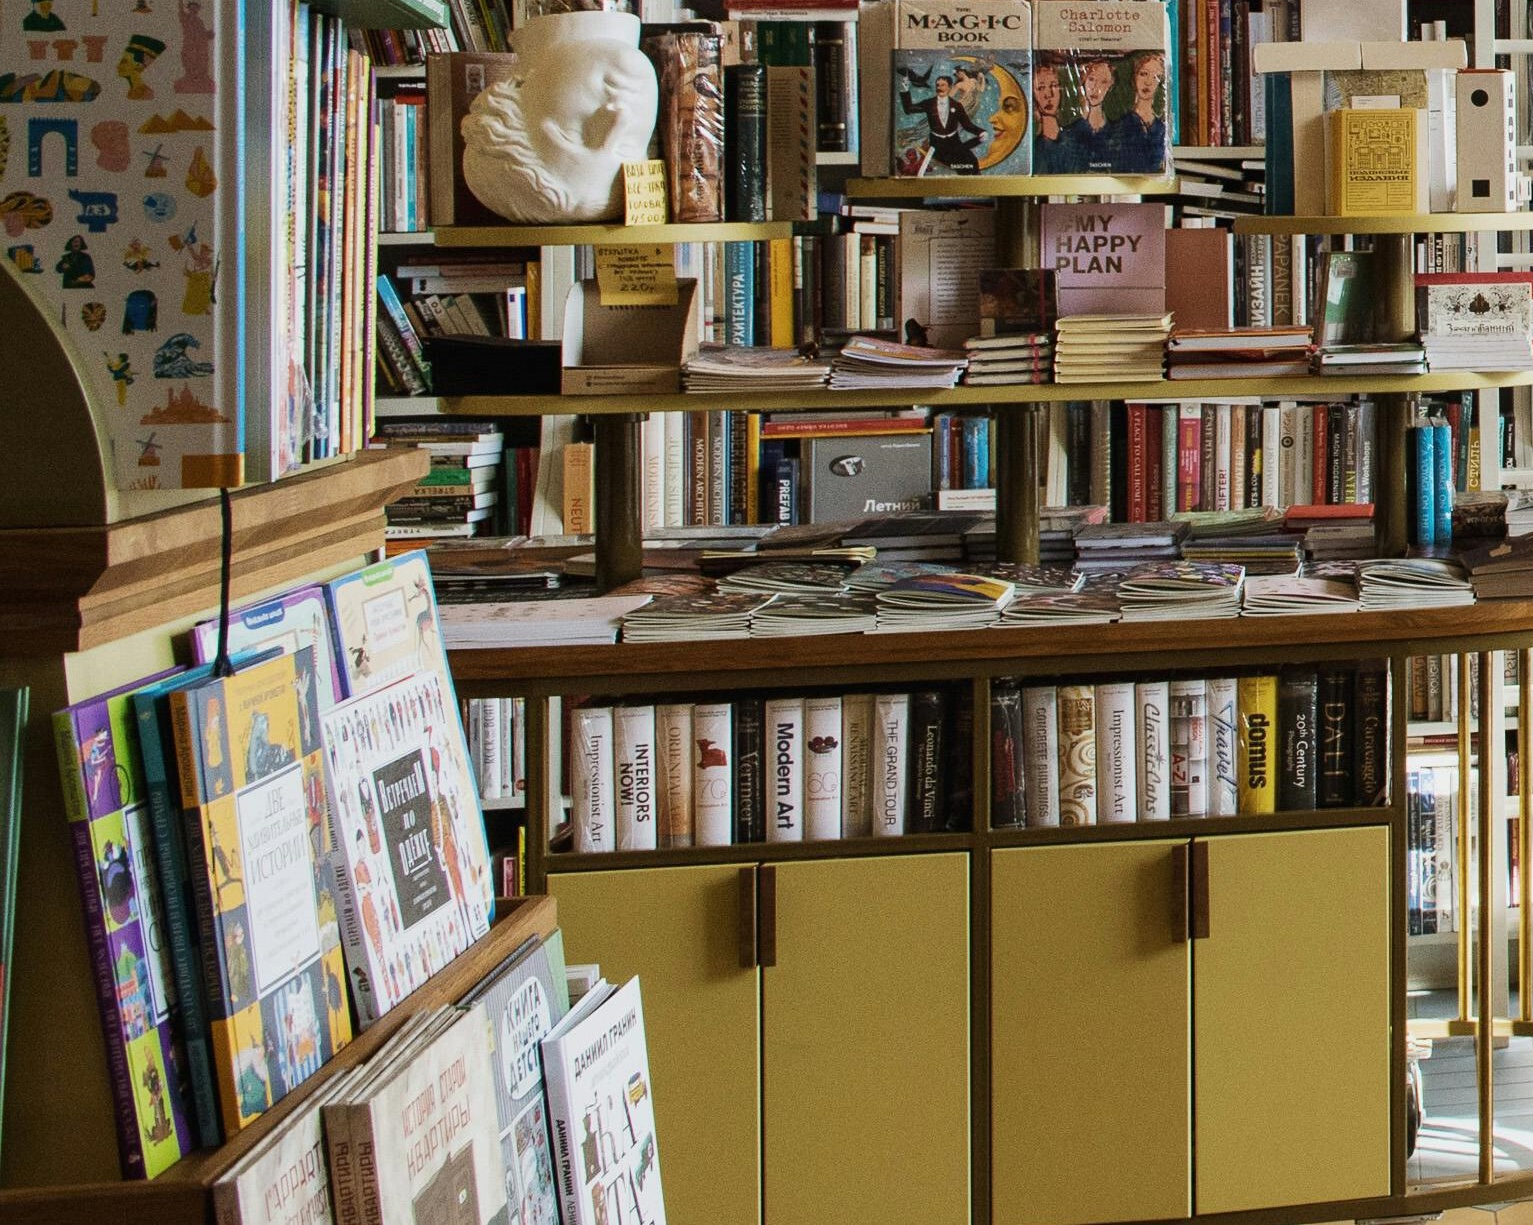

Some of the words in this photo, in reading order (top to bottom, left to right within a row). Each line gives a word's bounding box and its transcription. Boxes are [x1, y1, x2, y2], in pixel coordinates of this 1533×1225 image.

[1060, 8, 1141, 21] Charlotte
[1068, 21, 1133, 34] Salomon
[937, 31, 991, 44] BOOK
[1055, 235, 1143, 253] HAPPY
[1055, 255, 1123, 274] PLAN
[693, 437, 705, 480] MODERN
[711, 437, 722, 477] MODERN
[1361, 440, 1372, 486] Workshops
[1469, 441, 1480, 490] СТИЛЬ
[779, 478, 792, 518] PREFAB
[886, 718, 898, 742] THE
[1295, 713, 1306, 738] 20th
[776, 722, 795, 805] Modern
[886, 746, 898, 791] GRAND
[924, 725, 938, 774] Leonardo
[1113, 709, 1126, 789] Impressionist
[1171, 752, 1187, 783] A-Z
[1246, 712, 1267, 790] domus
[1296, 740, 1310, 789] Century
[588, 735, 604, 815] Impressionist
[620, 762, 634, 807] NOW!
[636, 743, 651, 823] INTERIORS
[738, 751, 754, 827] Vermeer
[263, 786, 287, 820] ДВЕ
[777, 807, 796, 831] Art
[886, 794, 898, 827] TOUR
[925, 786, 939, 819] Vinci
[1114, 792, 1127, 815] Art
[591, 819, 604, 844] Art
[250, 841, 309, 886] ИСТОРИИ
[502, 981, 543, 1034] КНИГА
[511, 1011, 541, 1060] НАШЕГО
[571, 1036, 608, 1083] ДАНИИЛ
[608, 1011, 639, 1054] ГРАНИН
[508, 1029, 547, 1097] ДЕТСТ
[401, 1082, 436, 1138] ИСТОРИЯ
[438, 1062, 467, 1103] СТАРОЙ
[404, 1101, 472, 1183] КВАРТИРЫ
[555, 1118, 569, 1158] ДАНИИЛ
[560, 1159, 575, 1197] ГРАНИН
